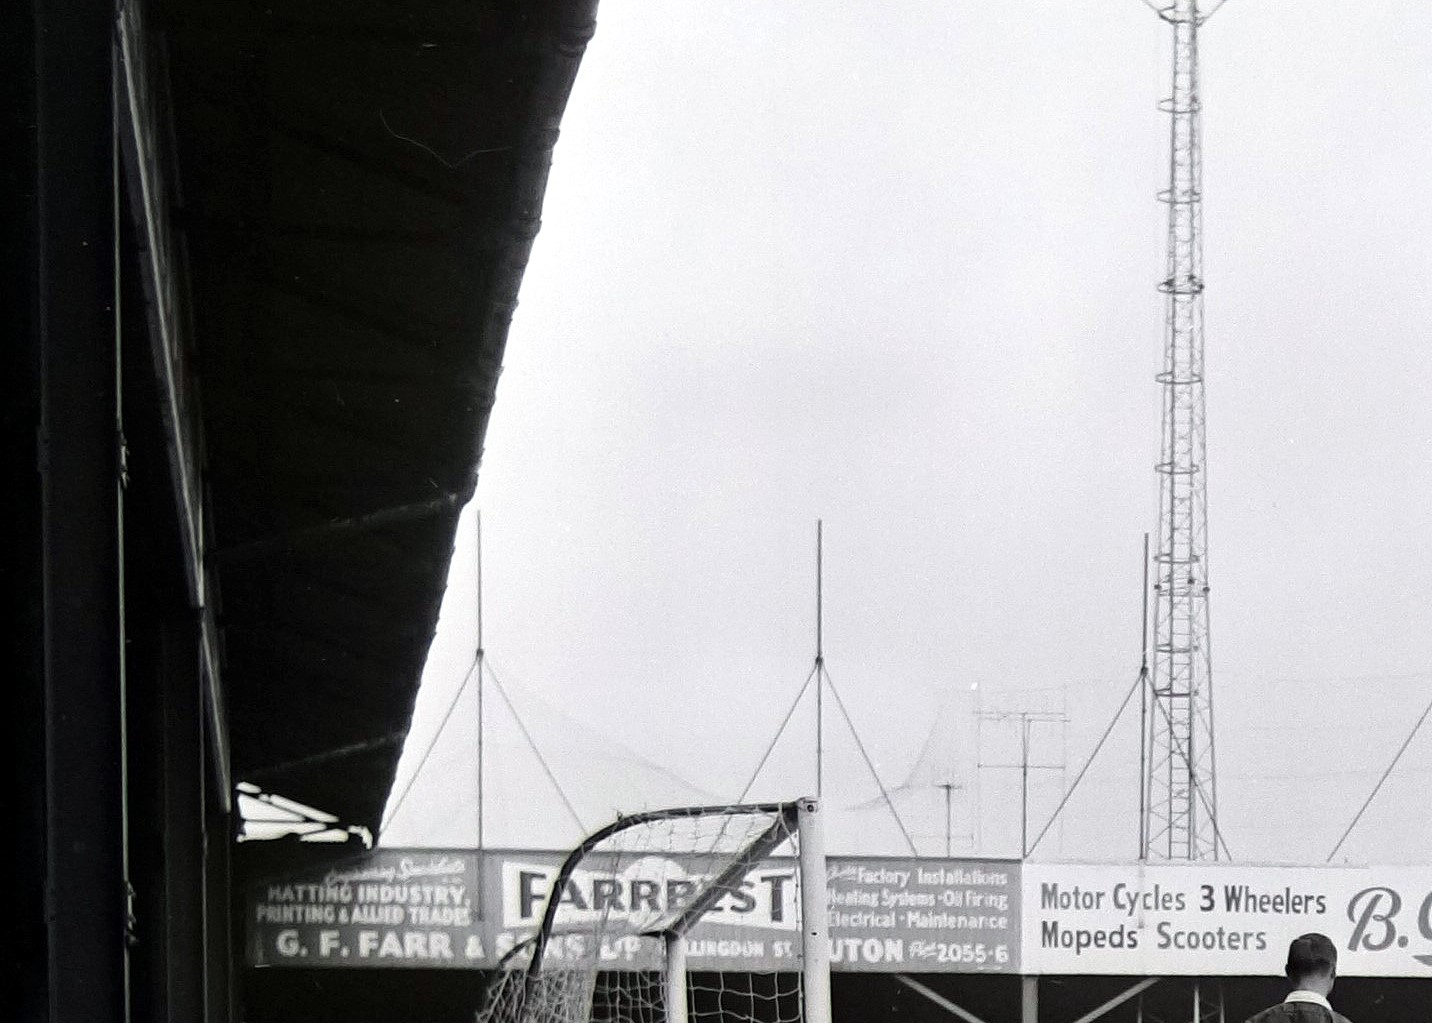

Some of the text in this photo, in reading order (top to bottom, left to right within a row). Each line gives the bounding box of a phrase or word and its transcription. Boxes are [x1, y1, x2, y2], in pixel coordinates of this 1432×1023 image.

[267, 884, 352, 904] HATTING
[1041, 883, 1326, 917] Motor Cycles 3 Wheelers
[359, 930, 455, 959] FARR
[828, 937, 904, 963] UTON
[1041, 923, 1267, 955] Mopeds Scooters
